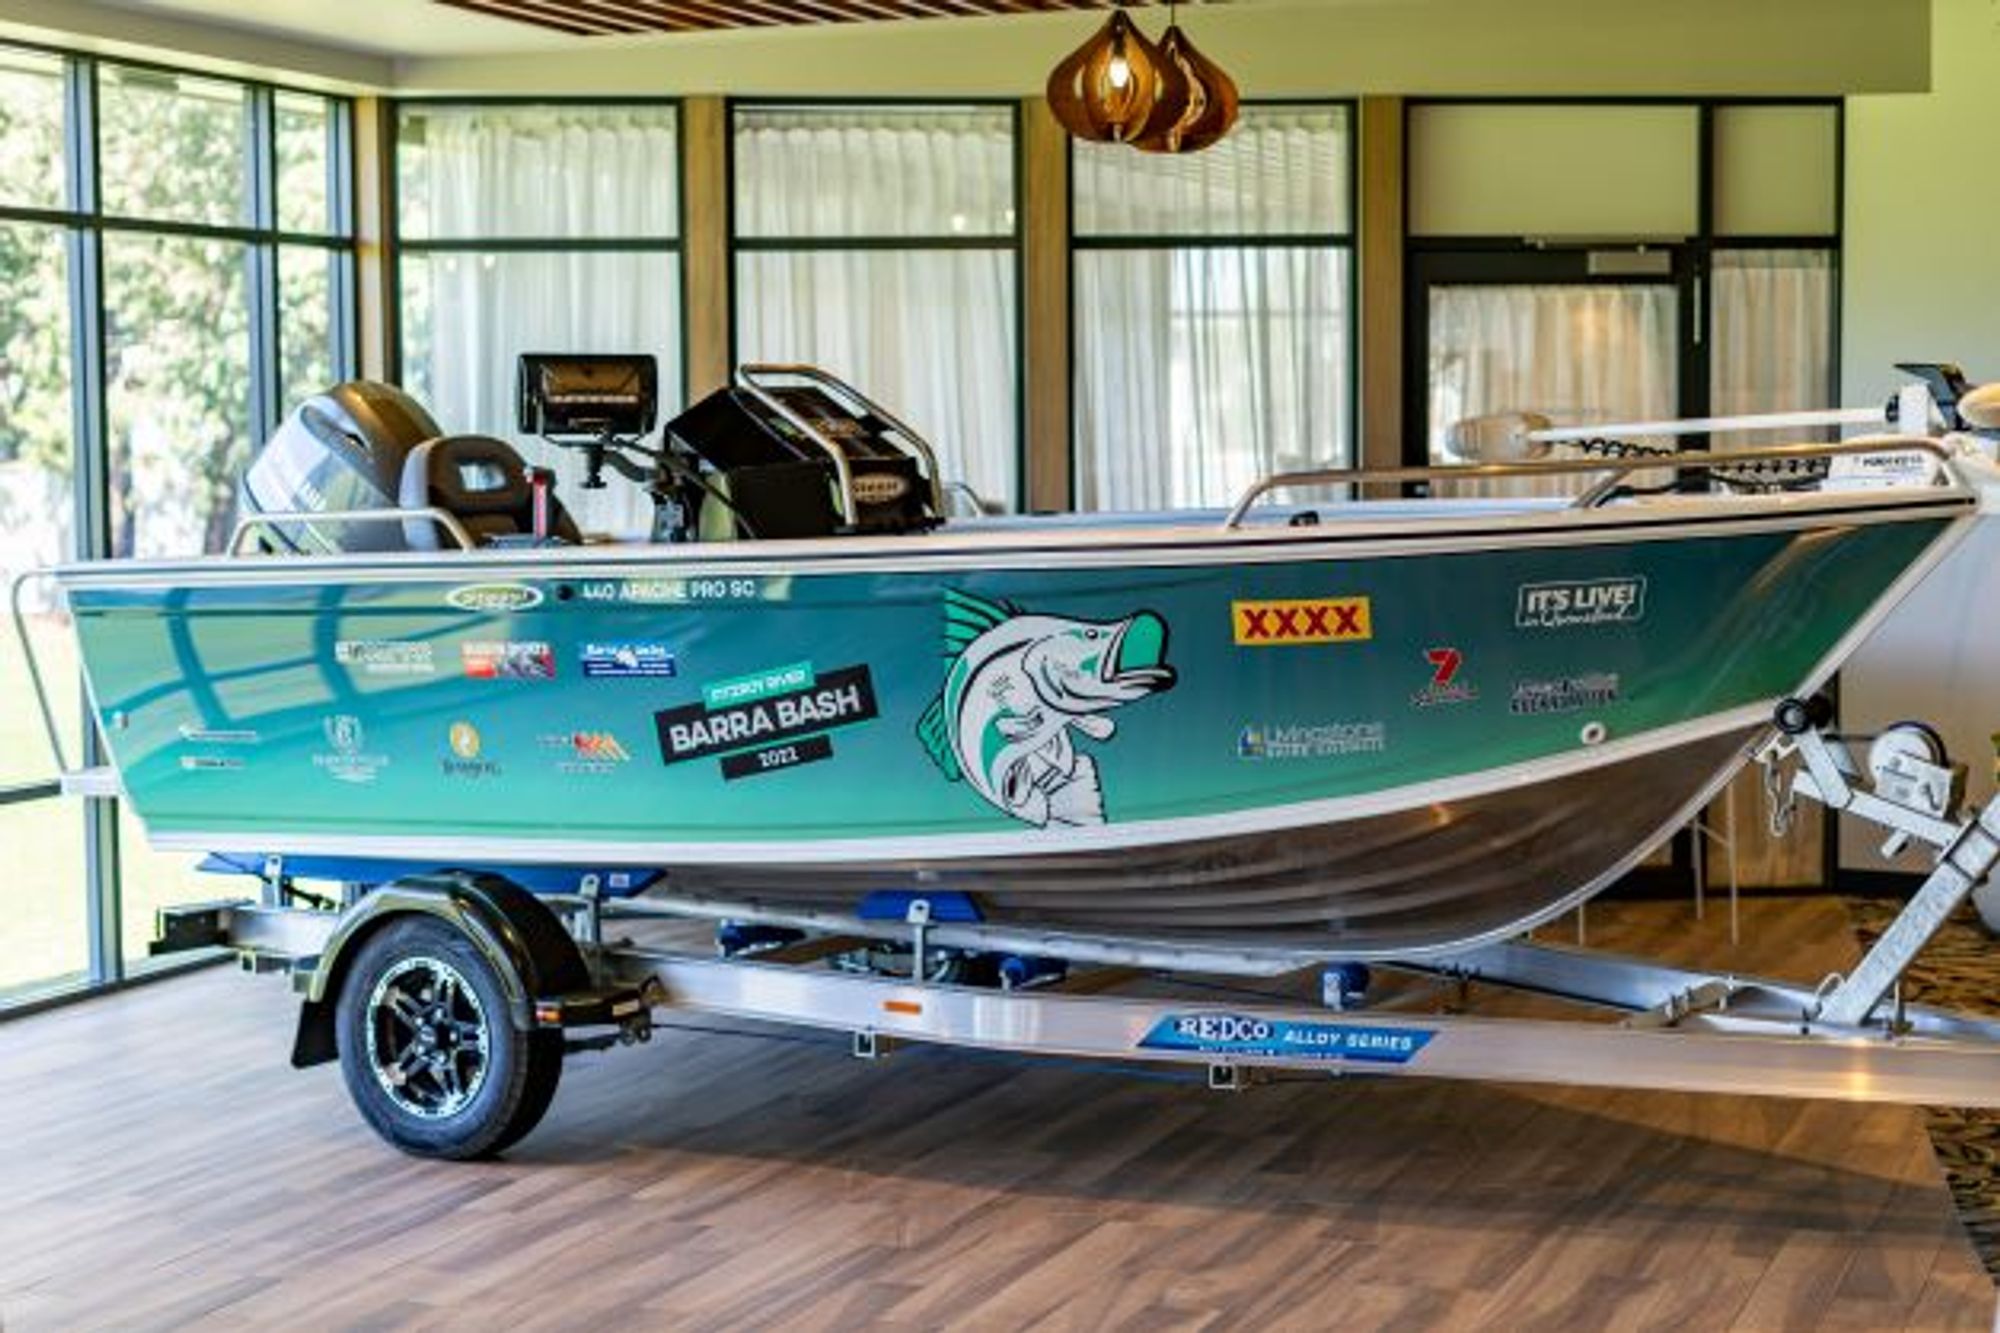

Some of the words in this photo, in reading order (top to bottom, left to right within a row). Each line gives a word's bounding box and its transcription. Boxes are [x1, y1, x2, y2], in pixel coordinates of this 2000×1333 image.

[692, 580, 725, 598] PRO
[1243, 605, 1362, 638] XXXX
[1425, 648, 1461, 684] 7
[669, 706, 775, 753] BARRA
[774, 685, 861, 730] BASH
[758, 746, 799, 768] 2022
[1178, 1017, 1269, 1041] REDCO
[1284, 1029, 1341, 1045] ALLOY
[1346, 1034, 1413, 1051] SERIES
